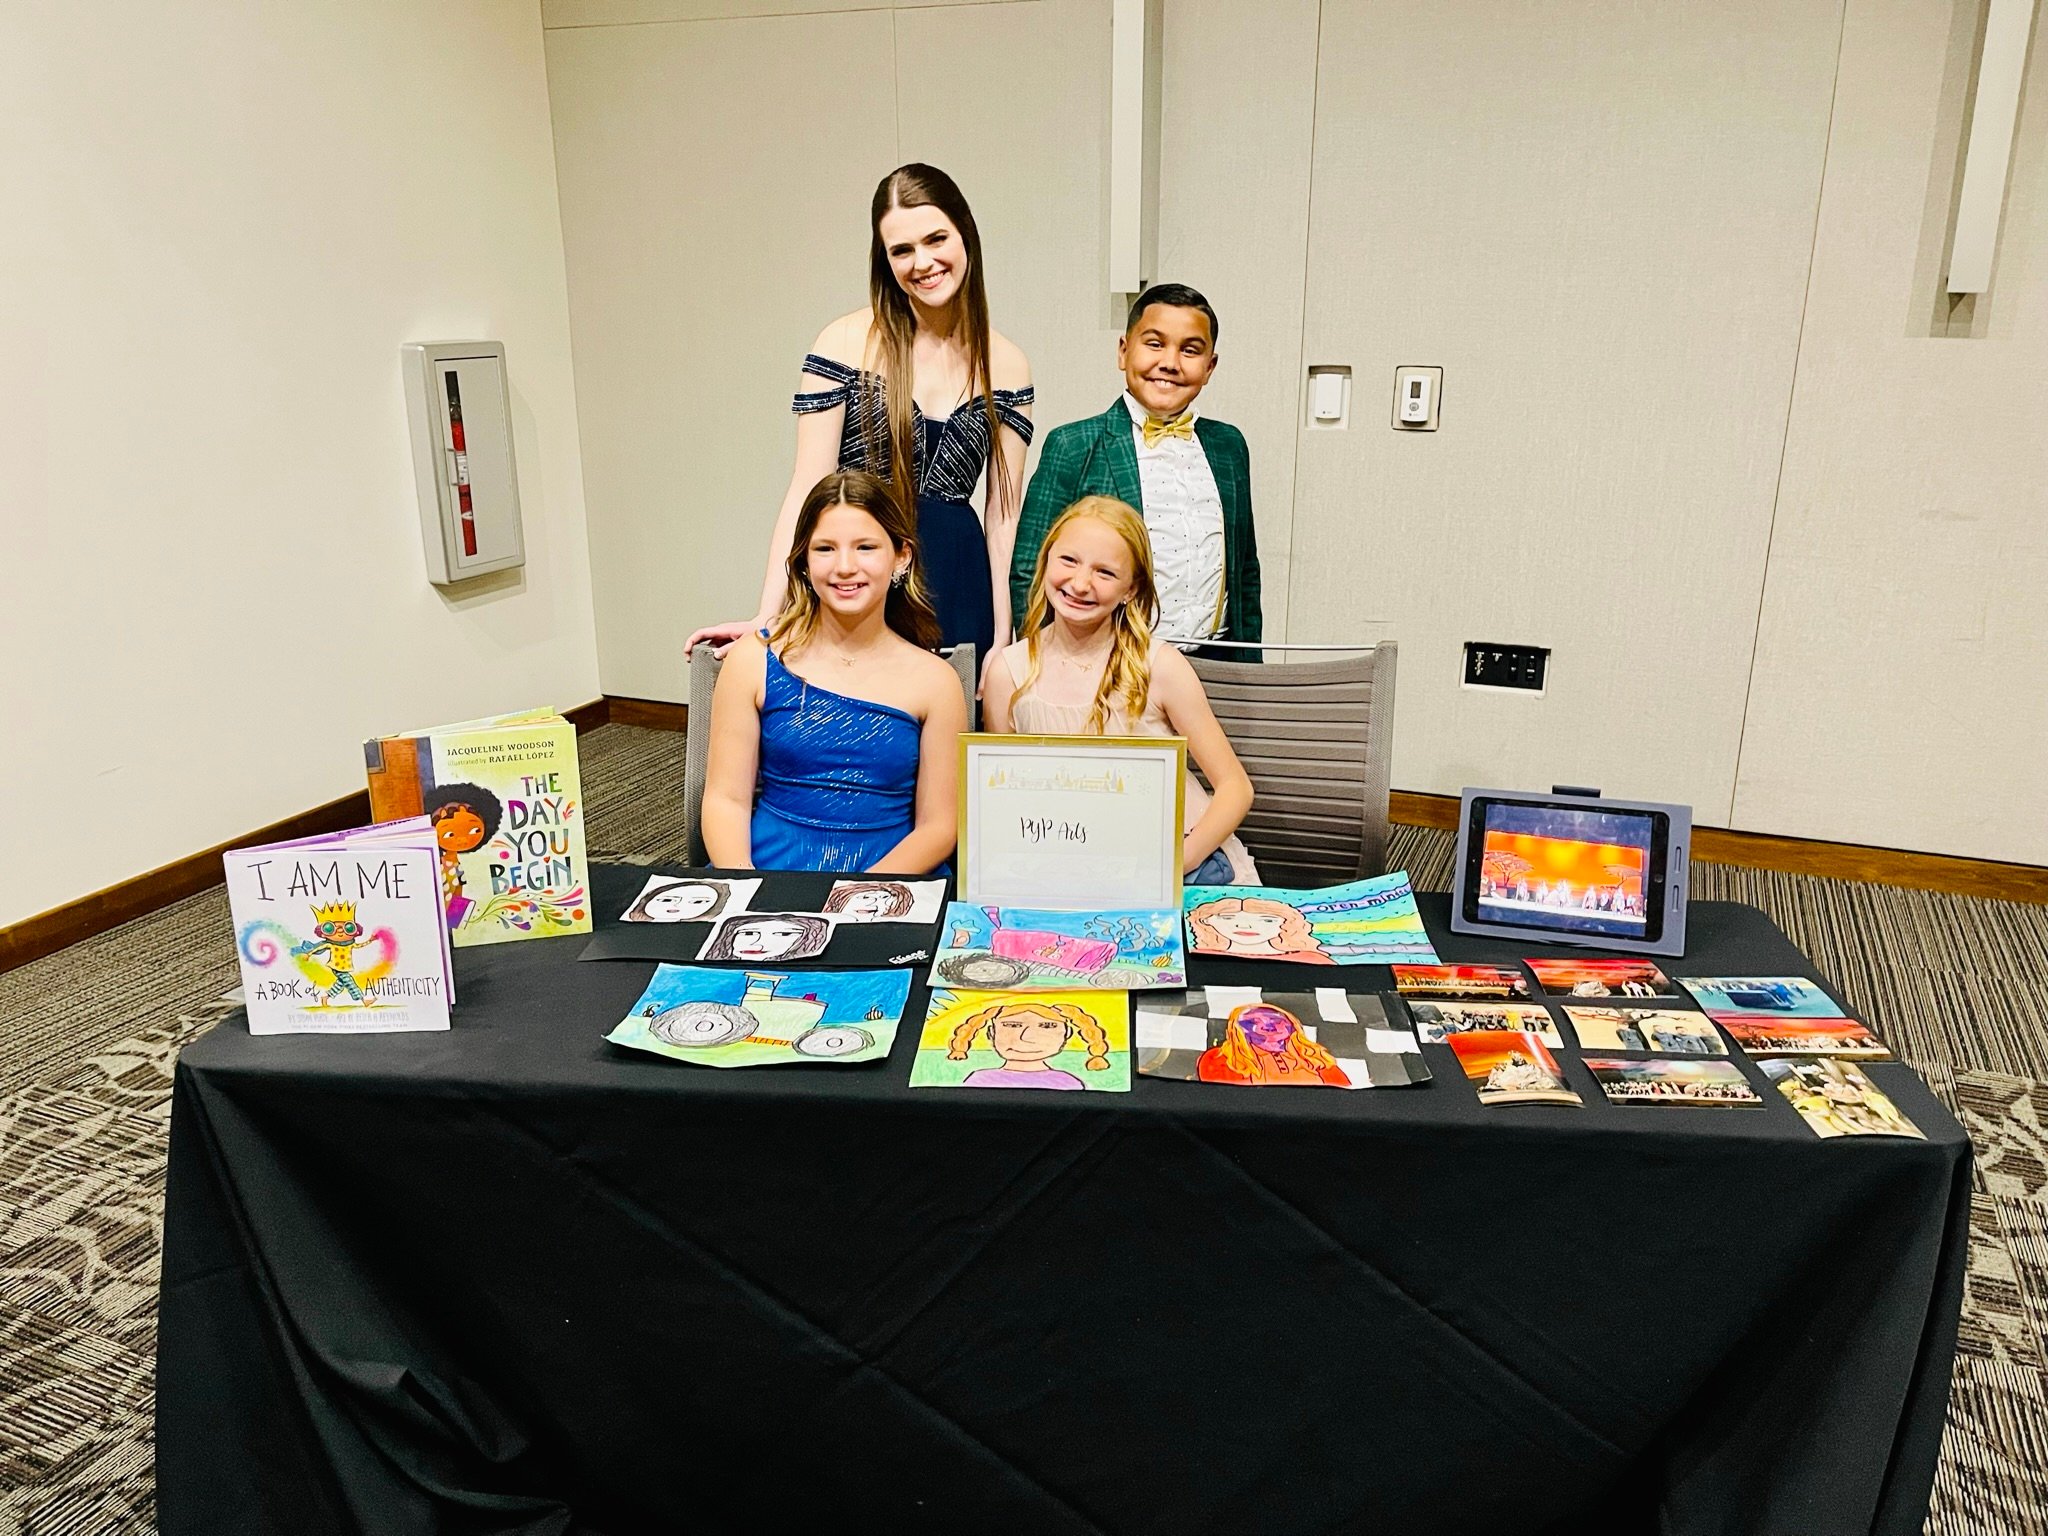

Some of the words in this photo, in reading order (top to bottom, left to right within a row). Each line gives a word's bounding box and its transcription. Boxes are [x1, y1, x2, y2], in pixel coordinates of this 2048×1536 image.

[448, 745, 504, 756] JACQUELINE
[507, 740, 555, 751] WOODSON
[489, 754, 525, 763] RAFAEL
[526, 751, 555, 760] LÓPEZ
[520, 772, 562, 797] THE
[508, 797, 563, 831] DAY
[503, 828, 569, 863] YOU
[247, 860, 275, 901] I
[287, 861, 342, 897] AM
[356, 860, 411, 899] ME
[254, 983, 268, 1000] A
[268, 979, 302, 1000] BOOK
[304, 981, 321, 1003] of
[364, 977, 440, 997] AUTHENTICITY
